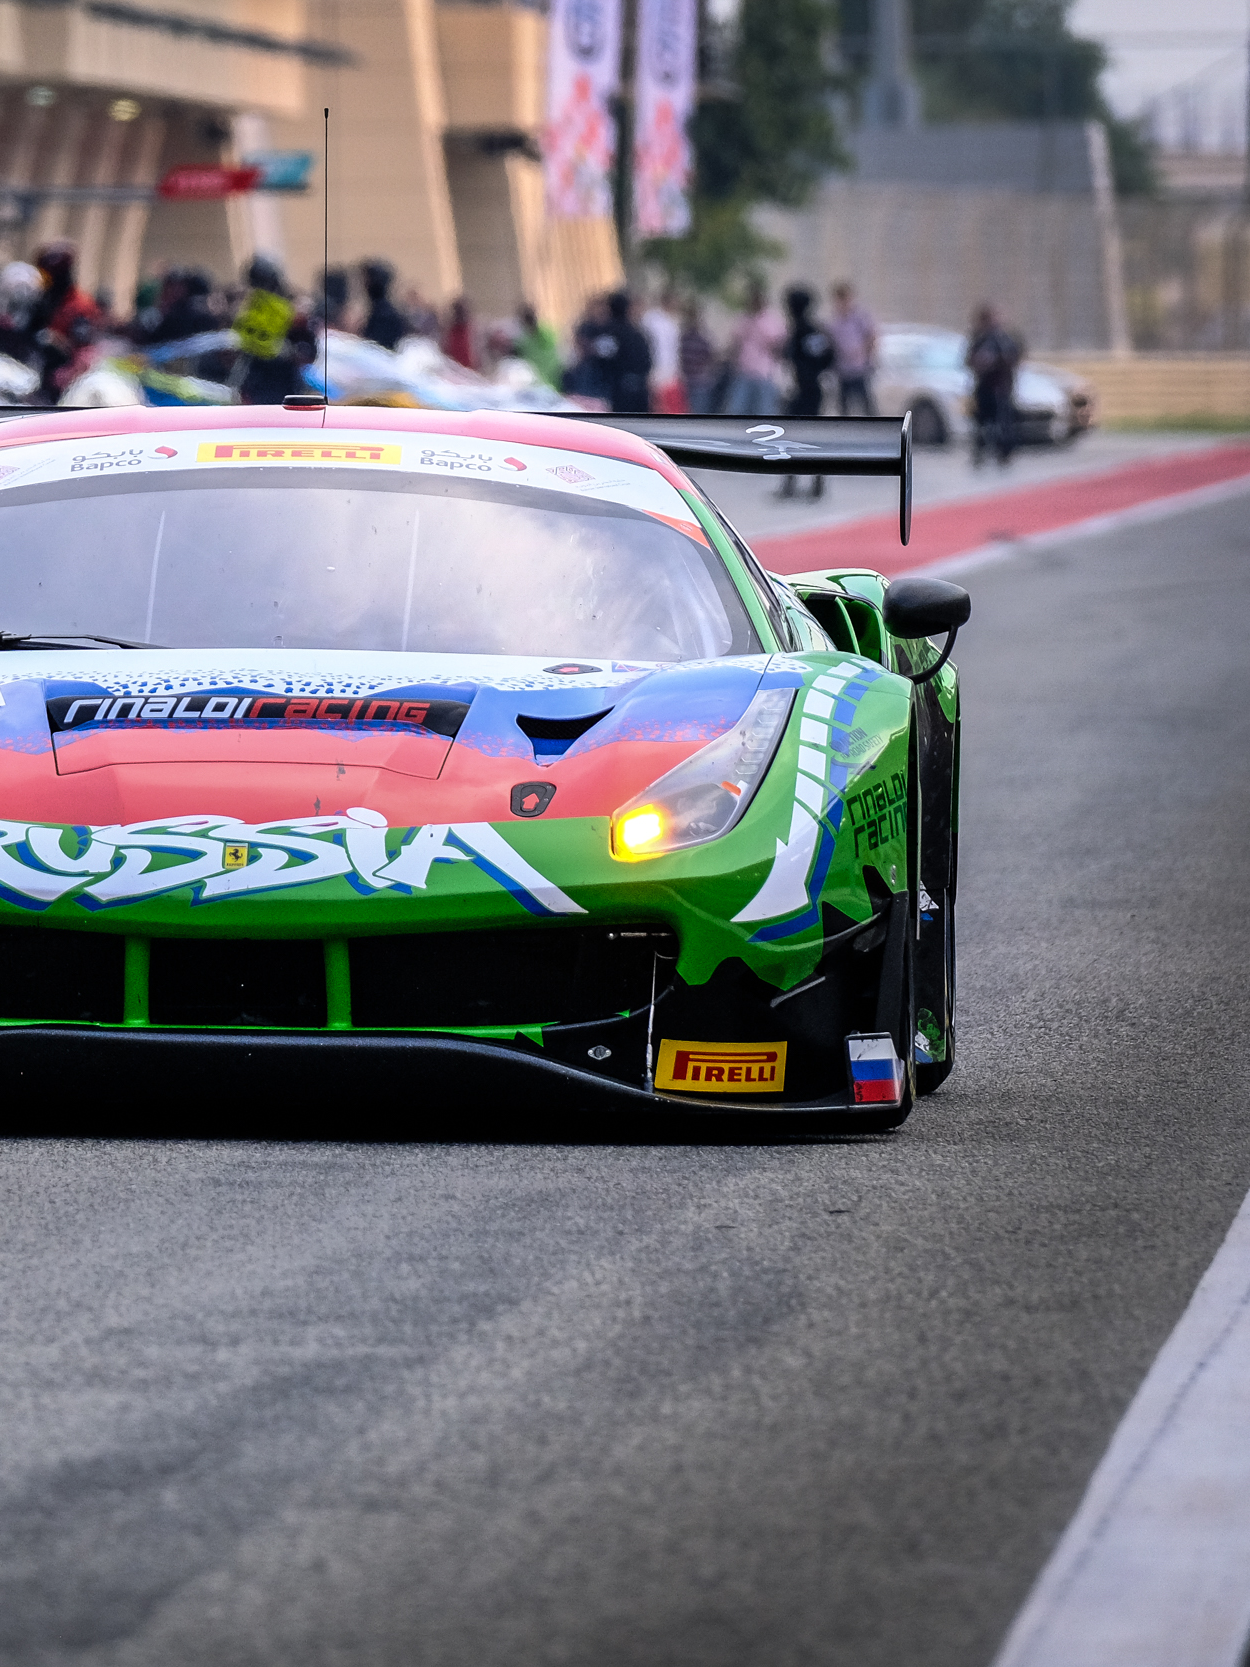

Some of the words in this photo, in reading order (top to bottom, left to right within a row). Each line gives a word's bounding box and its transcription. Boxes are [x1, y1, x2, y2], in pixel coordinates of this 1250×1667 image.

[214, 443, 385, 460] PIRELLI
[70, 458, 143, 473] Bapco
[420, 457, 492, 472] Bapco
[672, 1050, 778, 1083] PIRELLI
